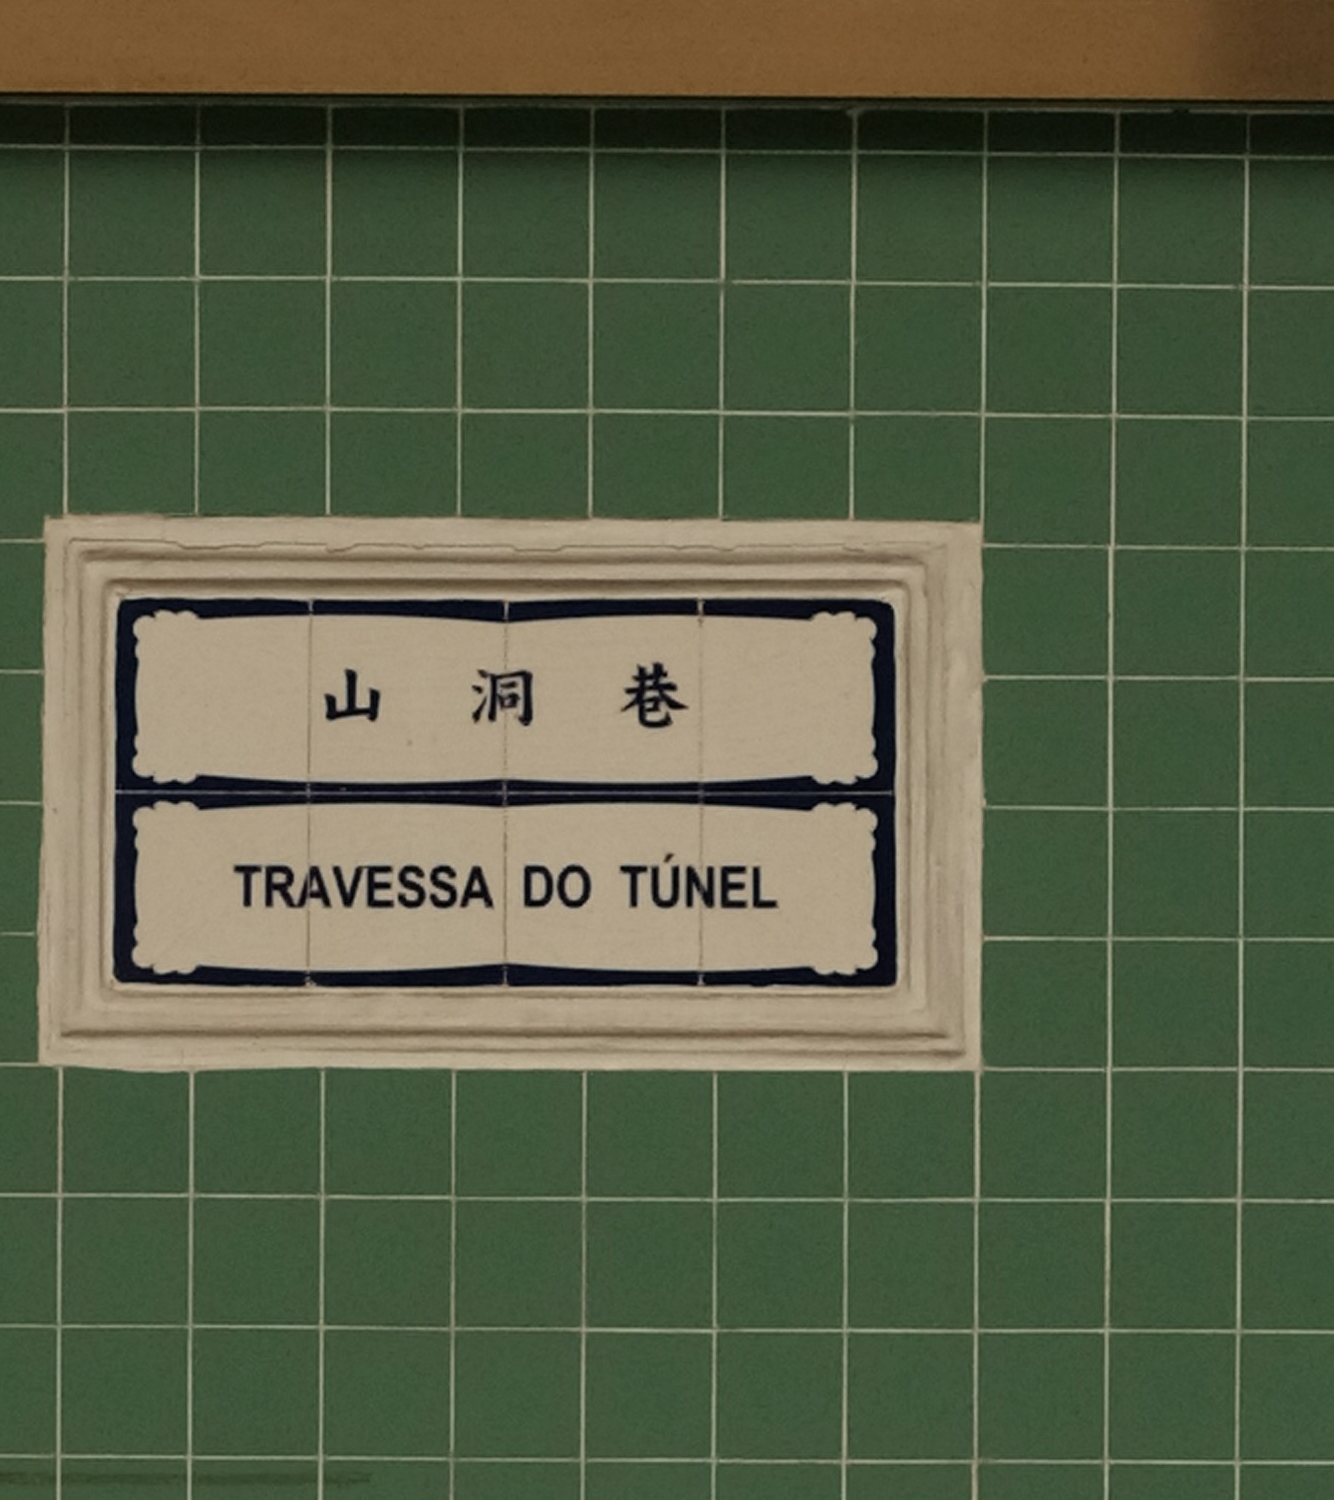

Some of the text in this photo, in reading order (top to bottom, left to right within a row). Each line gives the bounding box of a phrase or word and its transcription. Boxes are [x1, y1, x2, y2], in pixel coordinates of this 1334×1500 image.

[324, 661, 689, 729] 山洞巷
[233, 853, 777, 909] TRAVESSA DO TÚNEL
